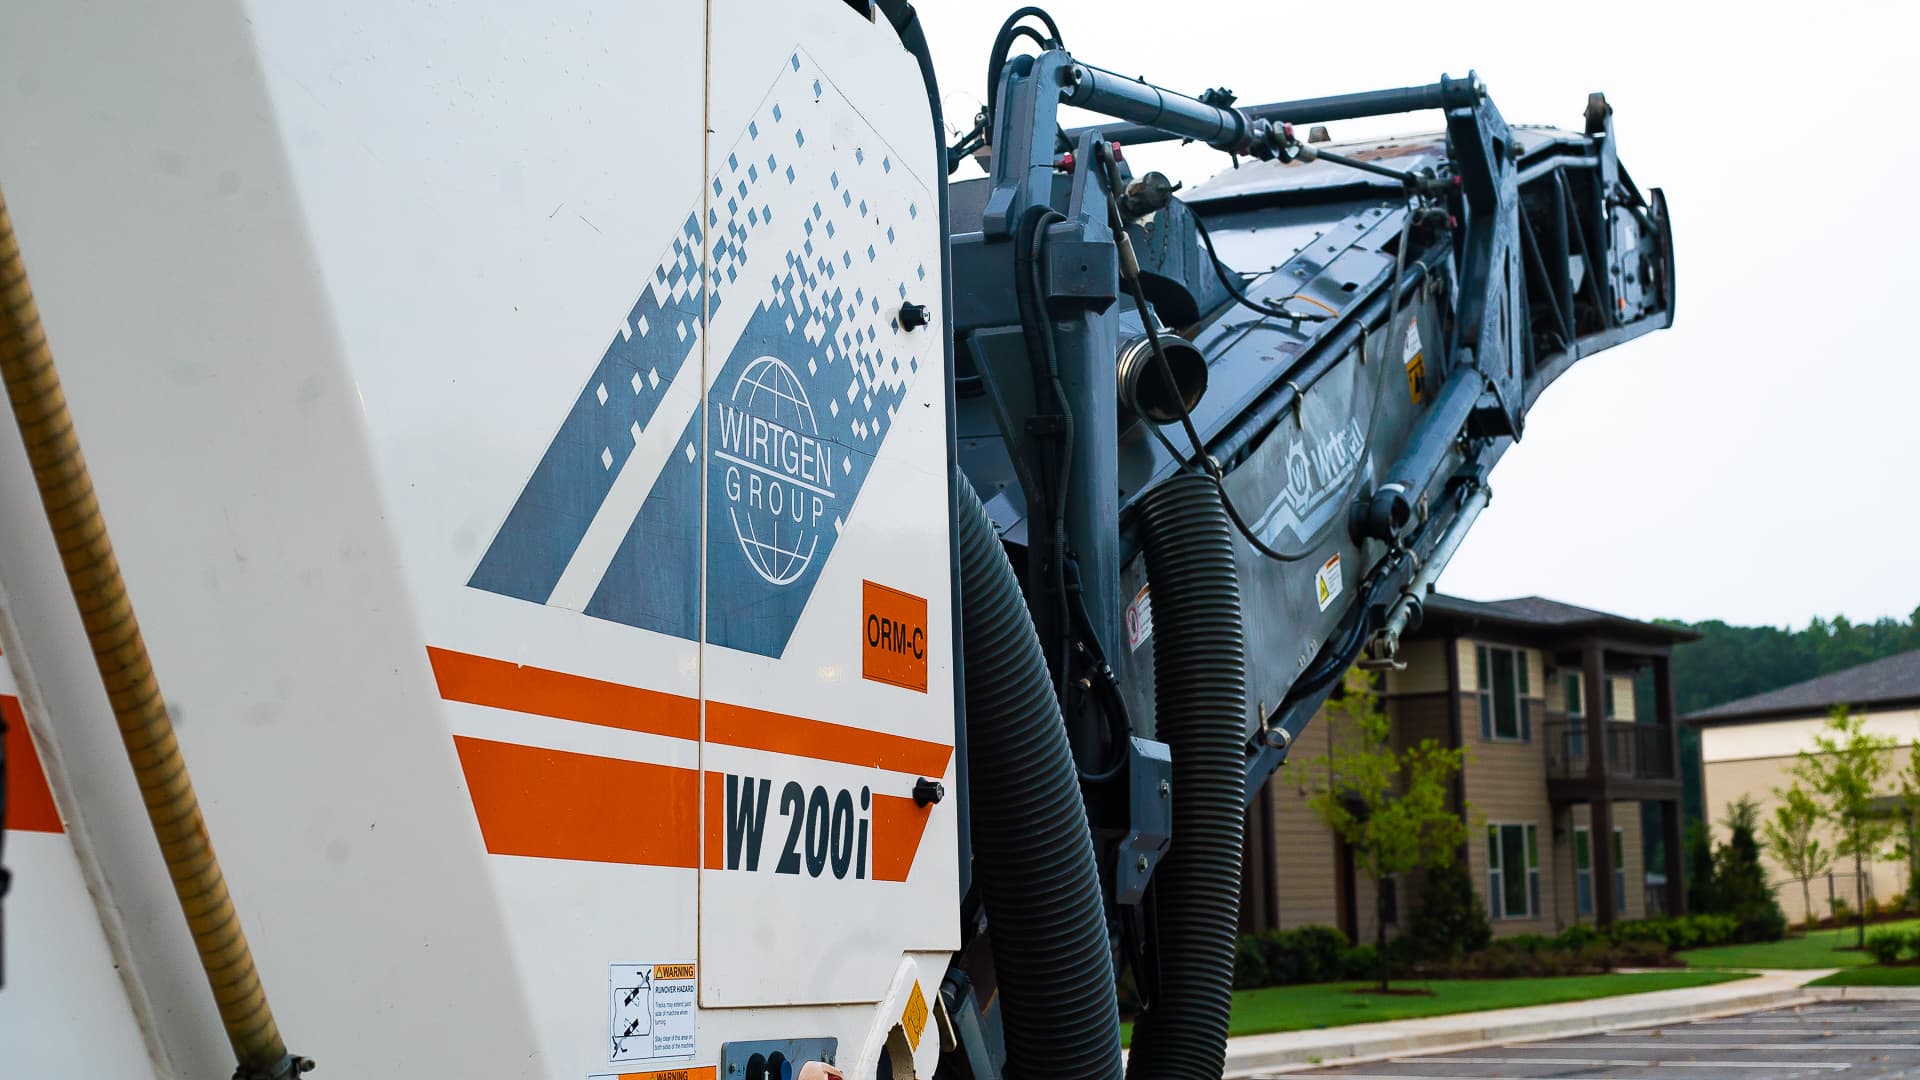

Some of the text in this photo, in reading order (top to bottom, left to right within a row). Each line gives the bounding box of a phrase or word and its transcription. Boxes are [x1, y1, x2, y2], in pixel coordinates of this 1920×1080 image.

[718, 402, 831, 487] WIRTGEN
[725, 466, 823, 528] GROUP
[867, 613, 923, 660] ORM-C
[726, 773, 871, 880] W 200i
[655, 985, 694, 994] RUNOVER HAZARD
[662, 966, 694, 977] WARNING
[656, 1071, 688, 1080] WARNING
